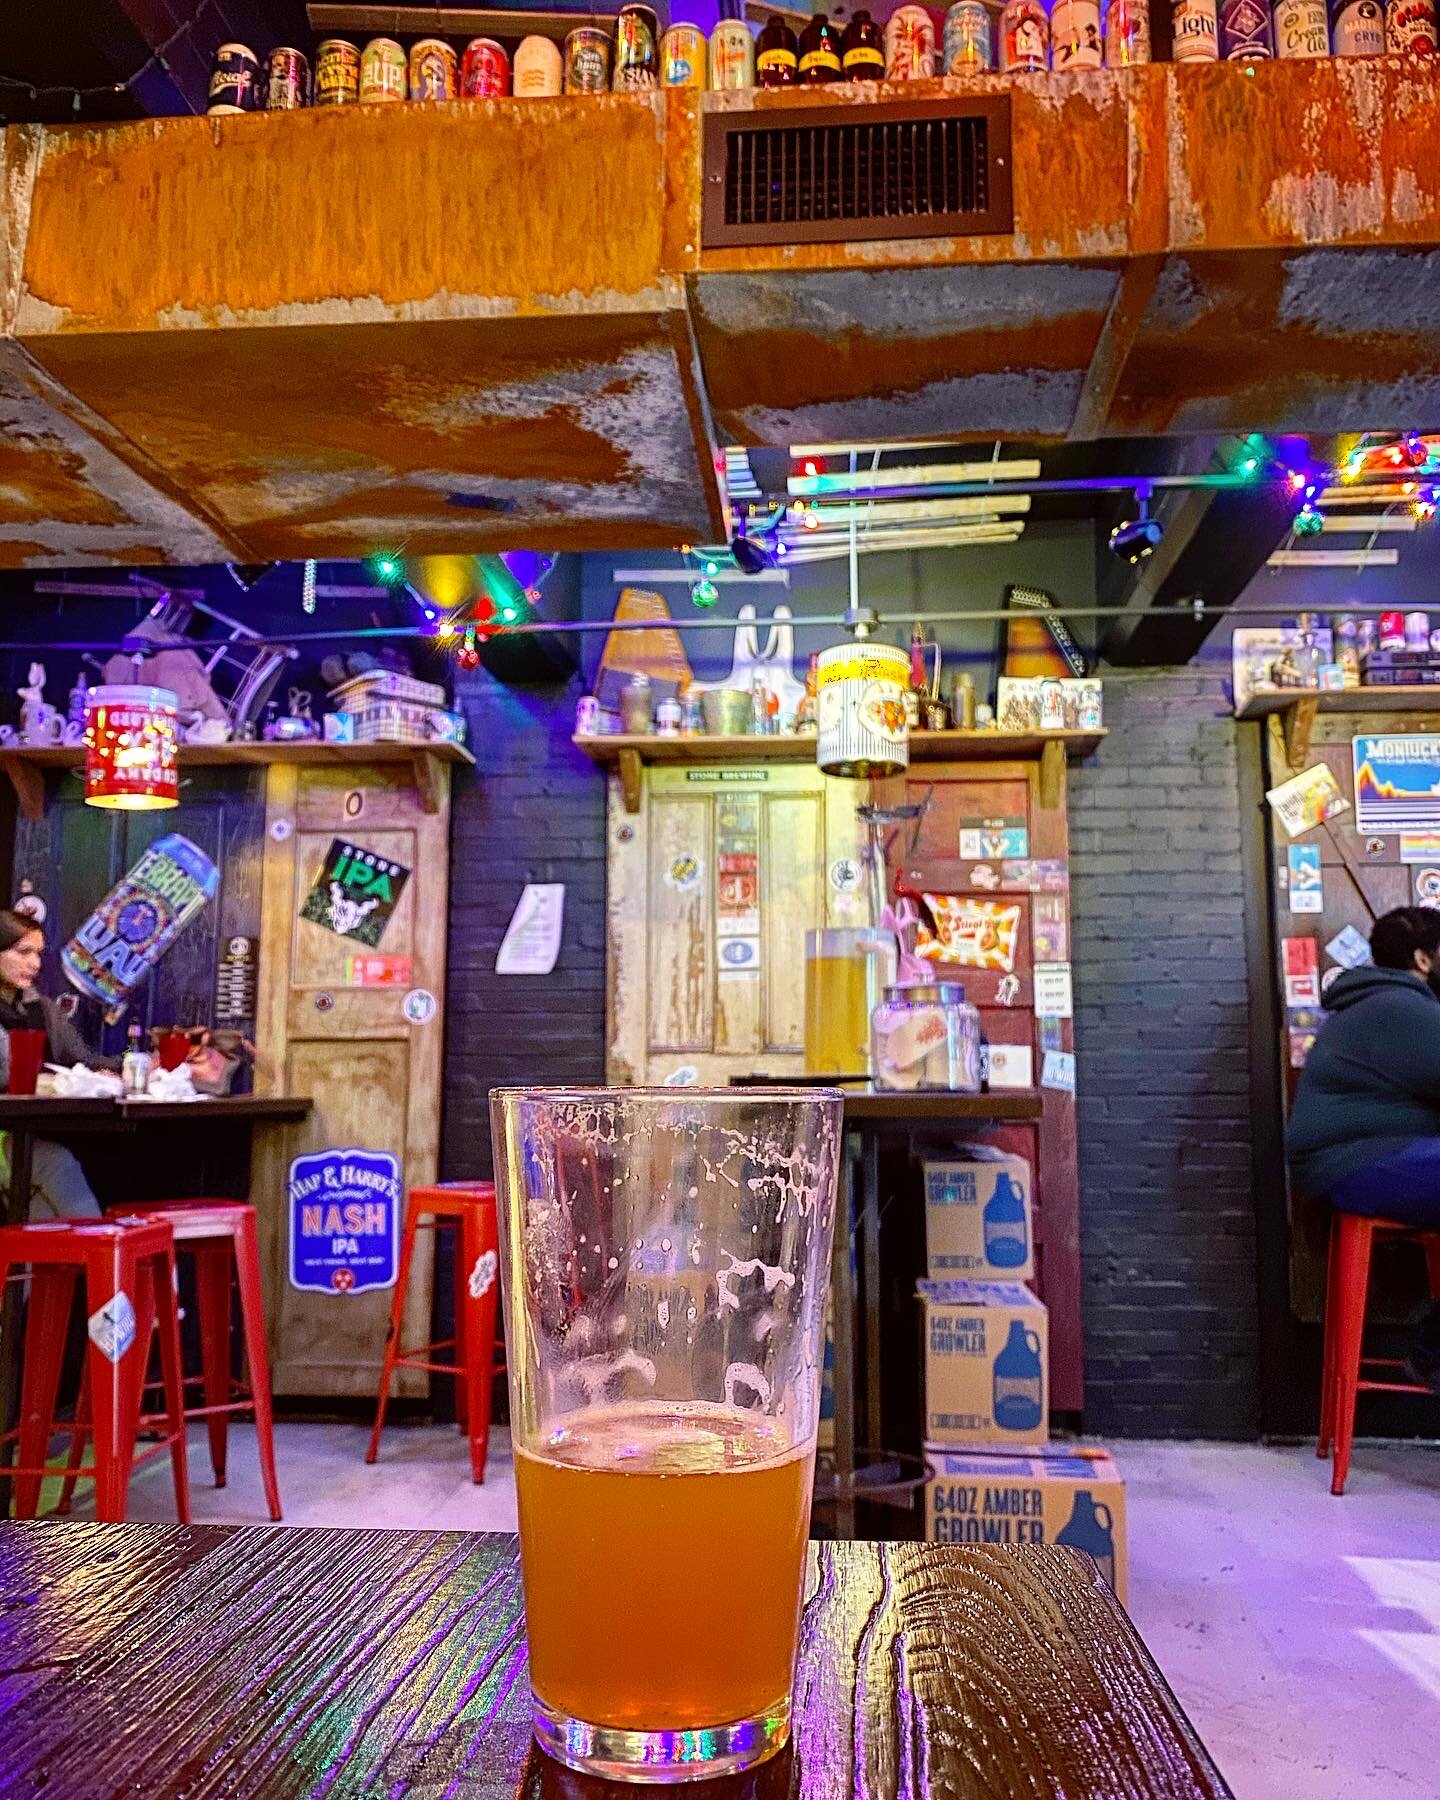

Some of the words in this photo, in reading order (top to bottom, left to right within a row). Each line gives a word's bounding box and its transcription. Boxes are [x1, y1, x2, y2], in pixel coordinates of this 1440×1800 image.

[342, 845, 400, 877] STONE
[329, 854, 392, 902] IPA
[289, 1172, 323, 1200] HAP
[323, 1165, 343, 1189] &
[341, 1165, 399, 1197] HARRY'S
[928, 1184, 976, 1202] GROWLER
[302, 1203, 386, 1237] NASH
[331, 1238, 359, 1255] IPA
[955, 1317, 985, 1332] AMBER
[930, 1332, 986, 1351] GROWLER
[934, 1485, 979, 1514] 64OZ
[982, 1487, 1044, 1517] AMBER
[934, 1516, 1045, 1545] GROWLER
